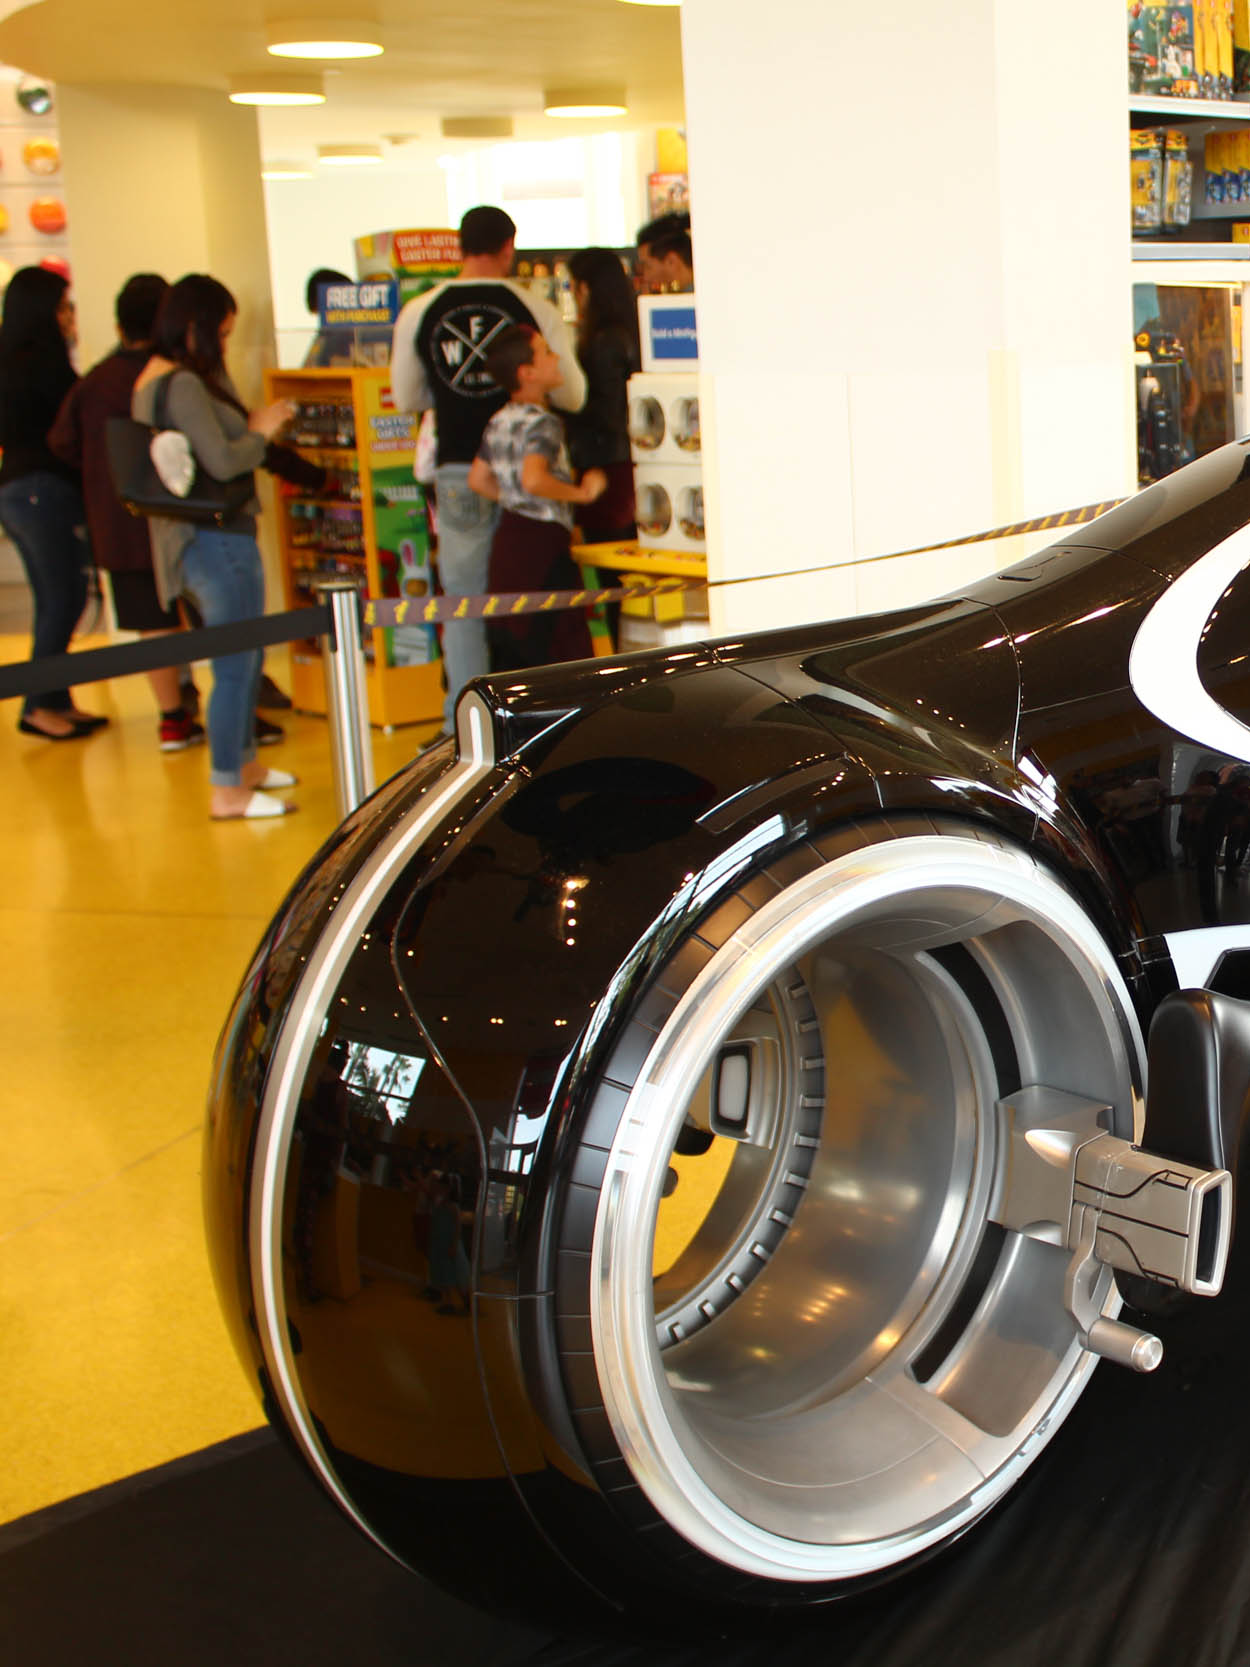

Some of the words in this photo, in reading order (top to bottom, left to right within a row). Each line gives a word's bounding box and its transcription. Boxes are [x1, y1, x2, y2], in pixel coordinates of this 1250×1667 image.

[326, 286, 358, 308] FREE
[360, 284, 389, 308] GIFT
[469, 316, 483, 341] F
[440, 340, 463, 367] W
